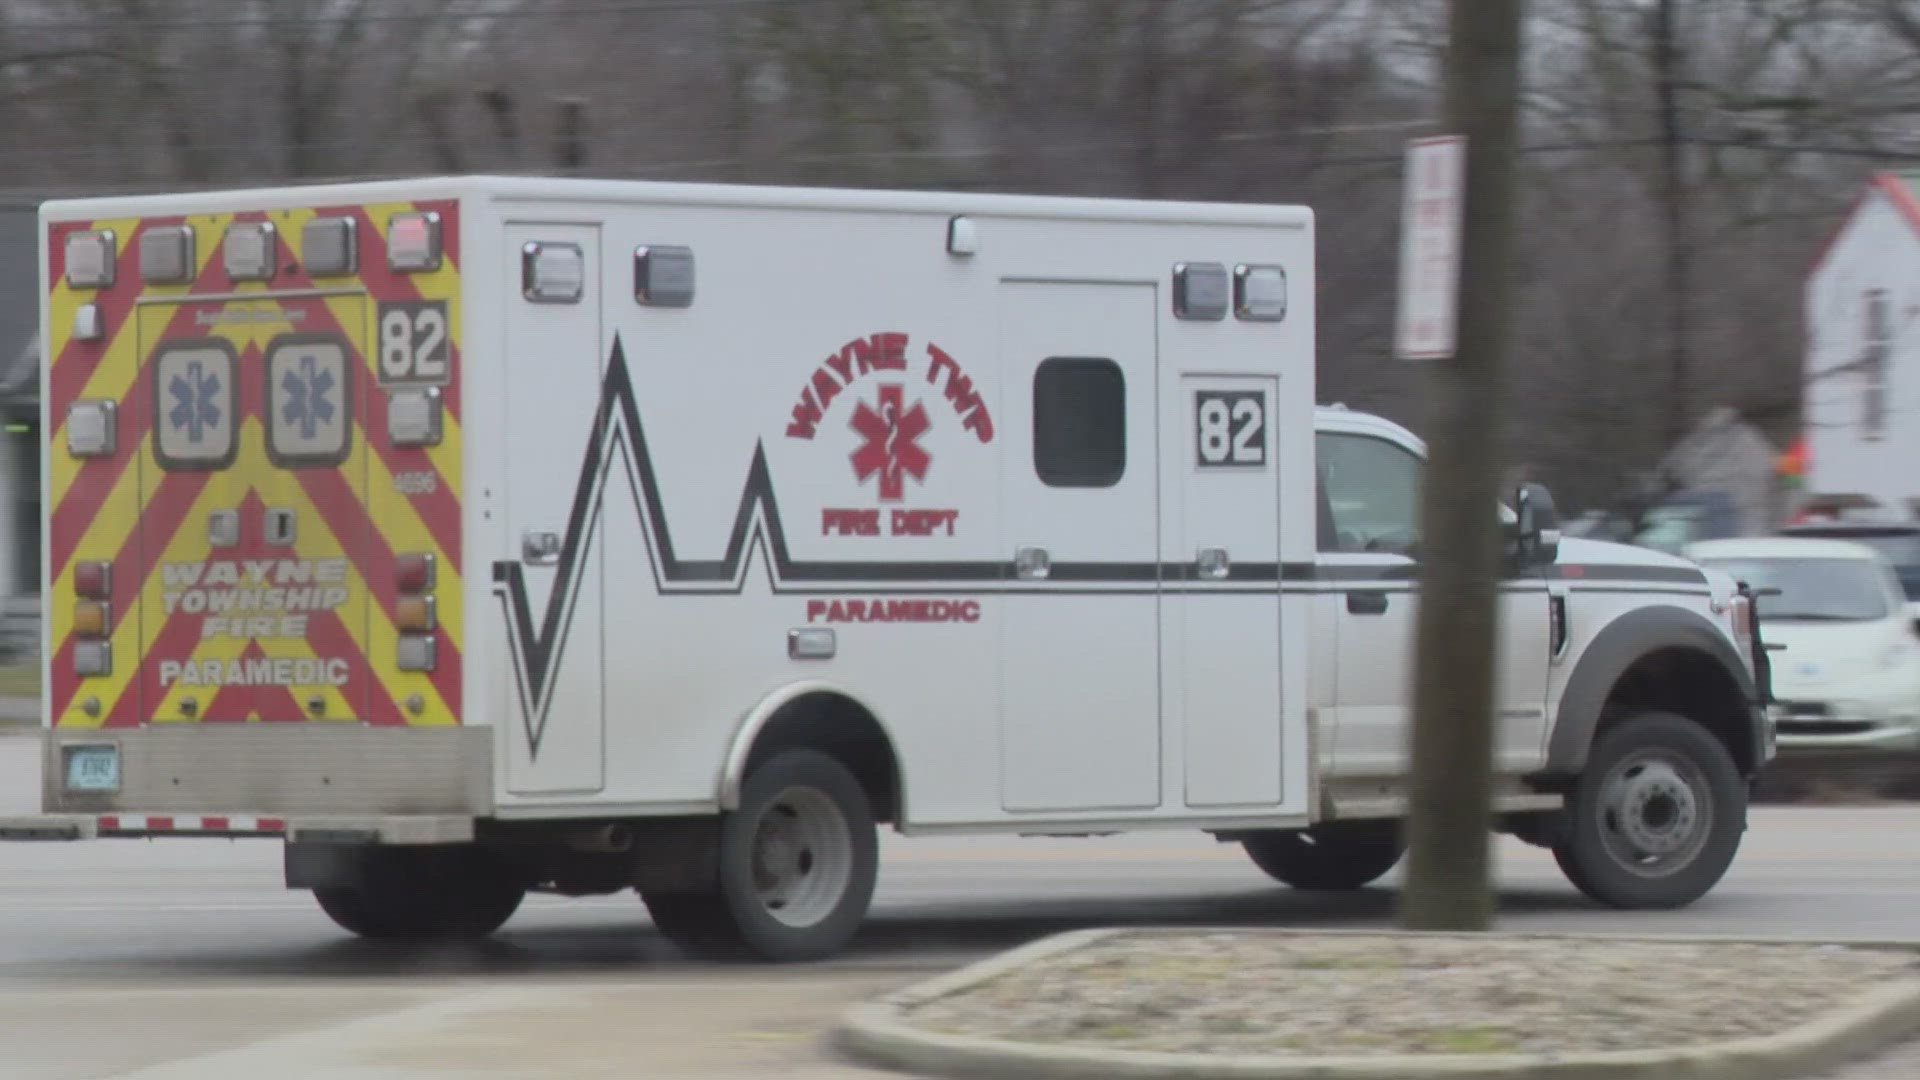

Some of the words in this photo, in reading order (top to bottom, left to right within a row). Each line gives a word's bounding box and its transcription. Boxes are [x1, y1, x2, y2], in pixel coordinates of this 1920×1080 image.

[382, 309, 445, 376] 82
[785, 332, 909, 440] WAYNE
[926, 342, 994, 443] TWP
[1200, 398, 1262, 462] 82
[821, 508, 880, 536] FIRE
[891, 508, 959, 536] DEPT
[162, 557, 347, 585] WAYNE
[162, 587, 348, 614] TOWNSHIP
[807, 600, 980, 622] PARAMEDIC
[201, 614, 309, 638] FIRE
[159, 658, 349, 686] PARAMEDIC
